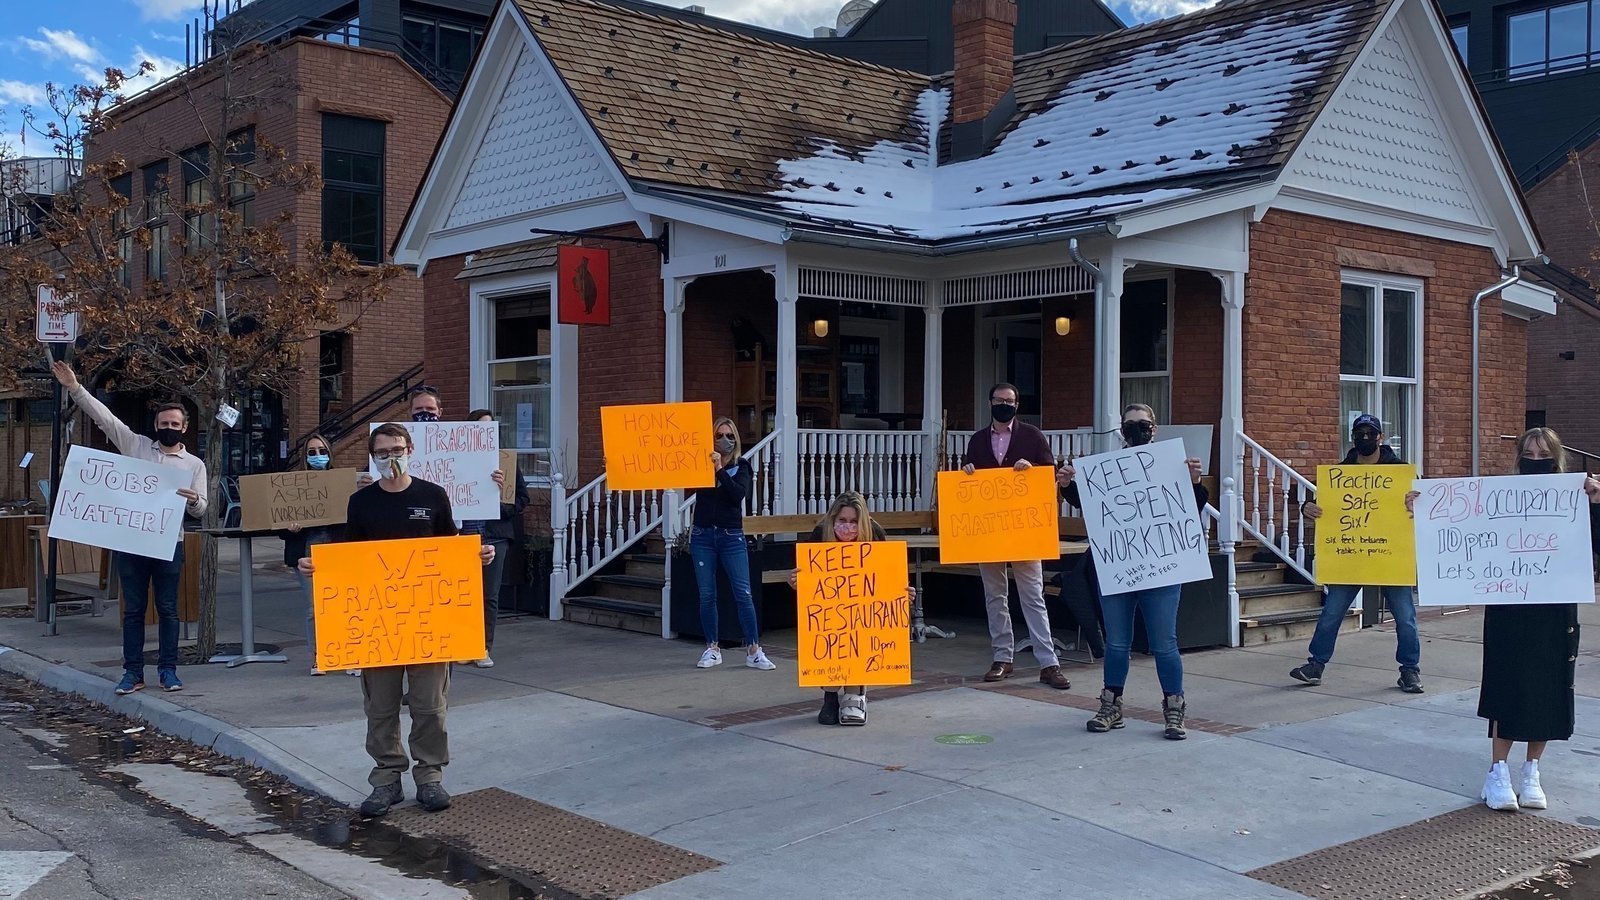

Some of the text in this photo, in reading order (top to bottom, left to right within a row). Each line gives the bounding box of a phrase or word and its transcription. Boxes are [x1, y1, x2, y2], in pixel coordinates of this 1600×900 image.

[714, 253, 726, 268] 101
[48, 322, 66, 330] TIME
[624, 412, 679, 432] HONK
[639, 434, 650, 448] IF
[408, 458, 456, 481] SAFE
[623, 449, 708, 474] HUNGRY!
[1083, 451, 1155, 497] KEEP
[81, 458, 158, 494] JOBS
[270, 472, 318, 488] KEEP
[957, 473, 1029, 503] JOBS
[1329, 467, 1393, 490] Practice
[273, 486, 328, 503] ASPEN
[1102, 481, 1186, 528] ASPEN
[1341, 491, 1379, 511] Safe
[1428, 479, 1580, 523] 25% occupancy
[60, 490, 173, 535] MATTER!
[271, 503, 325, 523] WORKING
[950, 503, 1052, 538] MATTER!
[1340, 512, 1371, 532] Six!
[1091, 519, 1201, 564] WORKING
[1506, 527, 1559, 551] close
[378, 547, 440, 580] WE
[809, 543, 872, 573] KEEP
[1483, 561, 1503, 578] do
[1511, 555, 1551, 577] this!
[813, 572, 876, 600] ASPEN
[1113, 575, 1124, 584] I
[1125, 563, 1146, 577] HAVE
[1126, 574, 1144, 588] BABY
[1158, 563, 1178, 575] FEED
[320, 577, 471, 615] PRACTICE
[346, 609, 432, 640] SAFE
[807, 596, 910, 632] RESTAURANTS
[324, 634, 452, 668] SERVICE
[814, 630, 859, 660] OPEN
